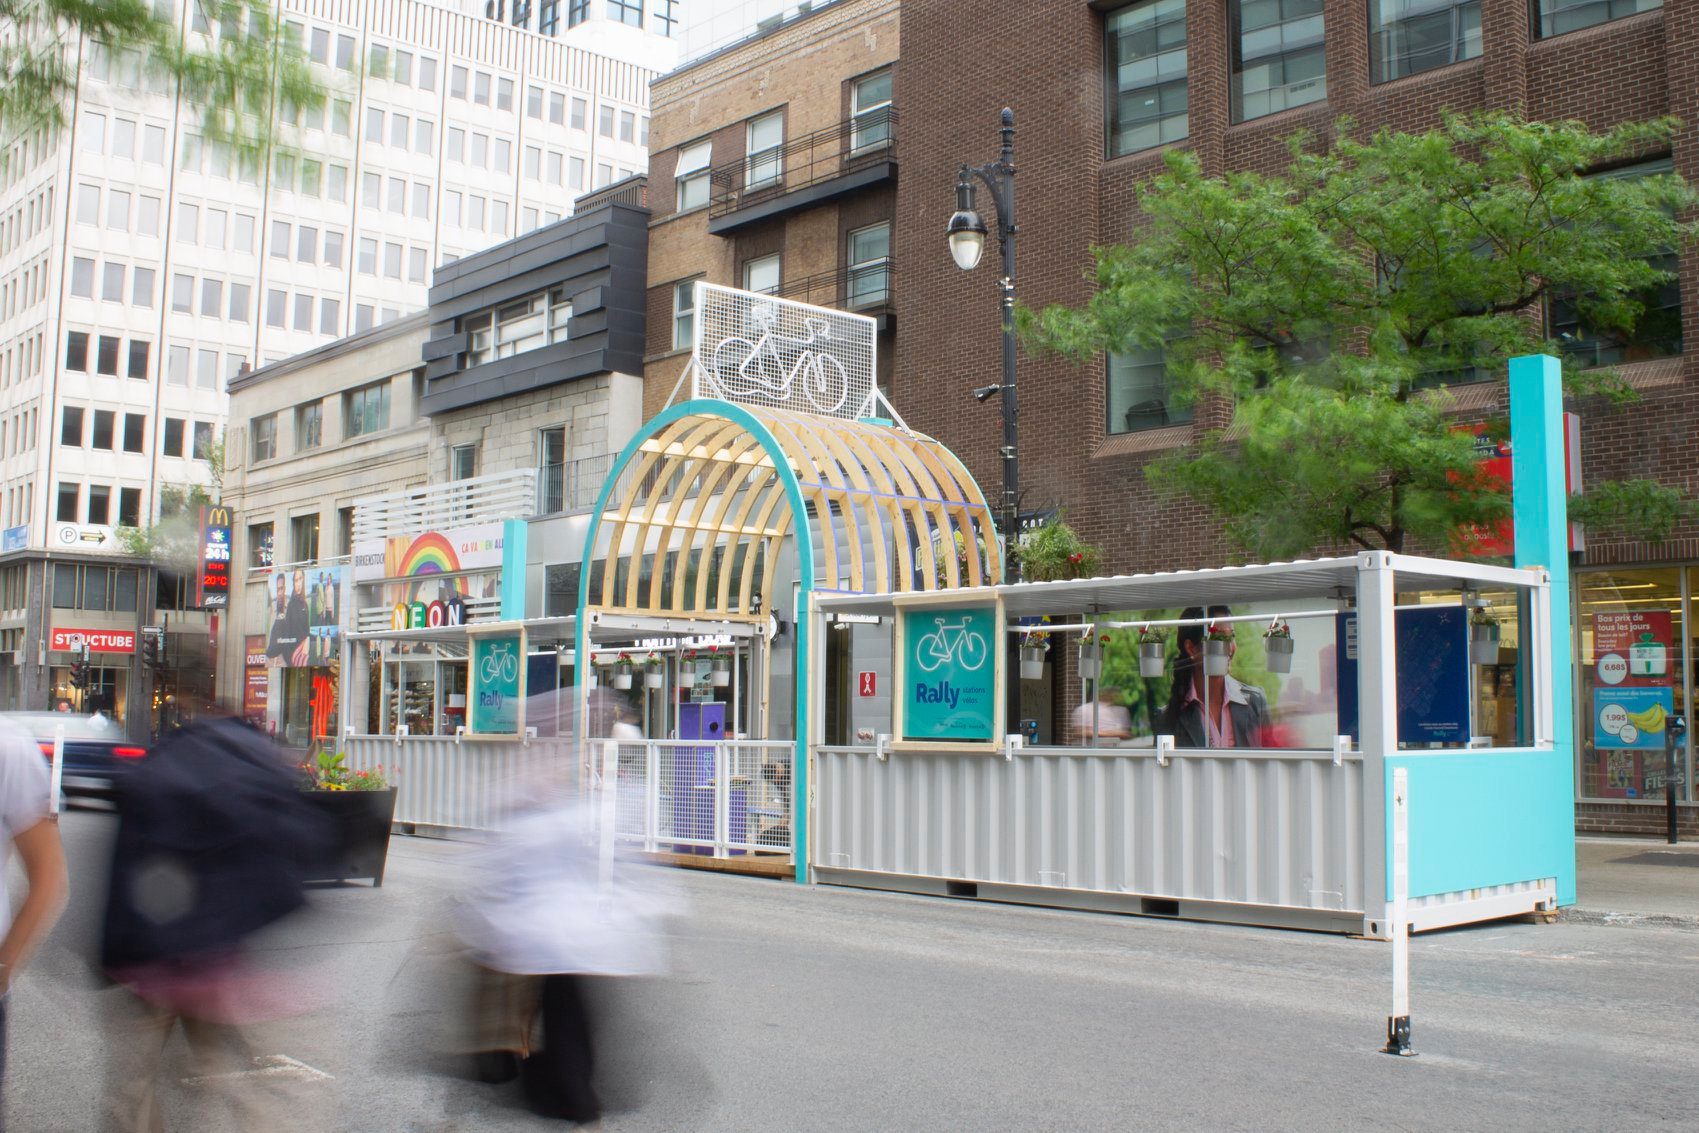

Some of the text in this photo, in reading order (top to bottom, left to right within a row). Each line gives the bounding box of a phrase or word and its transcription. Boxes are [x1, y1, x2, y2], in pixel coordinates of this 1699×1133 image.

[355, 552, 385, 567] BIRKENSTOC
[394, 604, 461, 630] NEON
[1615, 614, 1631, 624] prix
[1632, 613, 1644, 622] de
[1630, 623, 1650, 632] jours
[55, 633, 133, 647] STUCTUBE
[480, 690, 503, 711] Rally
[916, 681, 961, 709] Rally
